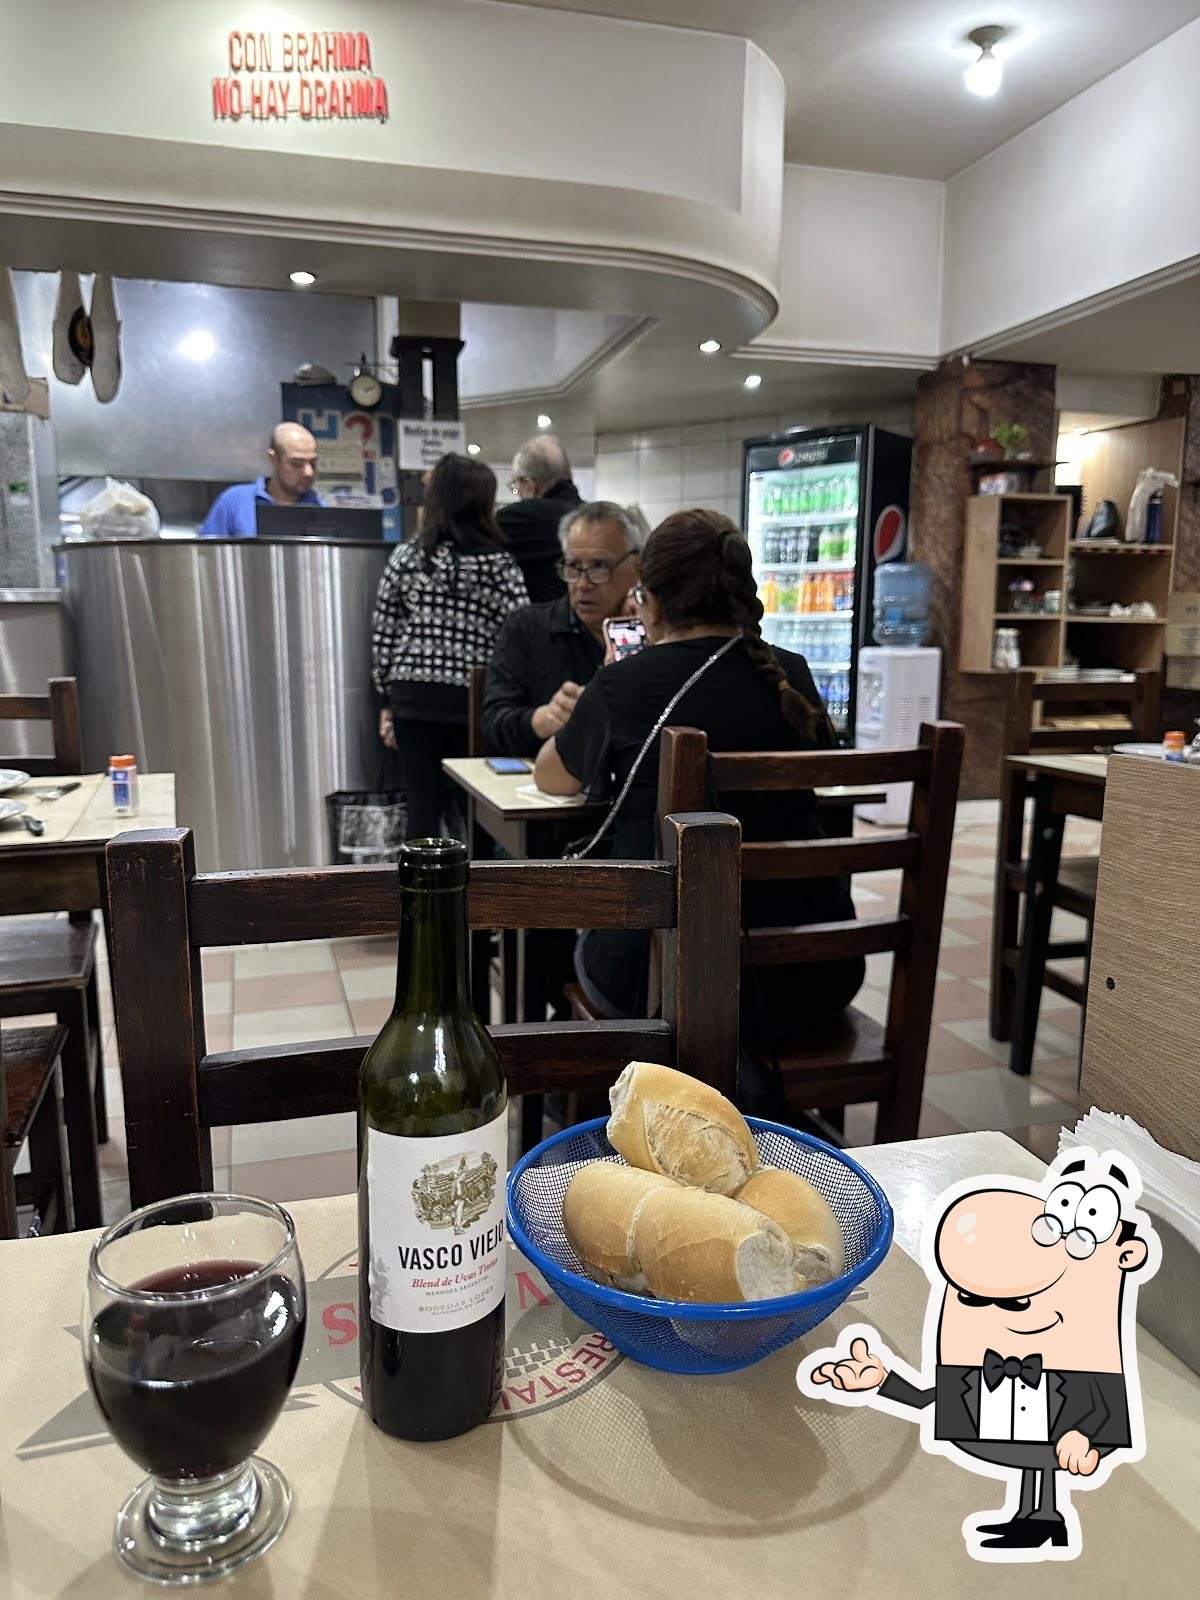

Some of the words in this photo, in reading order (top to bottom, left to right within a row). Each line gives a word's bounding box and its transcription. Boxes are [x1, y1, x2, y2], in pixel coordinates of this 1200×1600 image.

[229, 31, 272, 72] CON
[282, 32, 372, 72] BRAHMA
[213, 78, 243, 120] NO
[251, 79, 291, 121] HAY
[300, 78, 388, 121] DRAHMA
[398, 1244, 463, 1271] VASCO
[469, 1219, 504, 1261] VIEJO
[411, 1276, 440, 1289] Blend
[441, 1277, 453, 1287] de
[455, 1272, 477, 1284] Uvas
[426, 1287, 458, 1296] MENDOZA
[419, 1300, 466, 1312] BODEGAS
